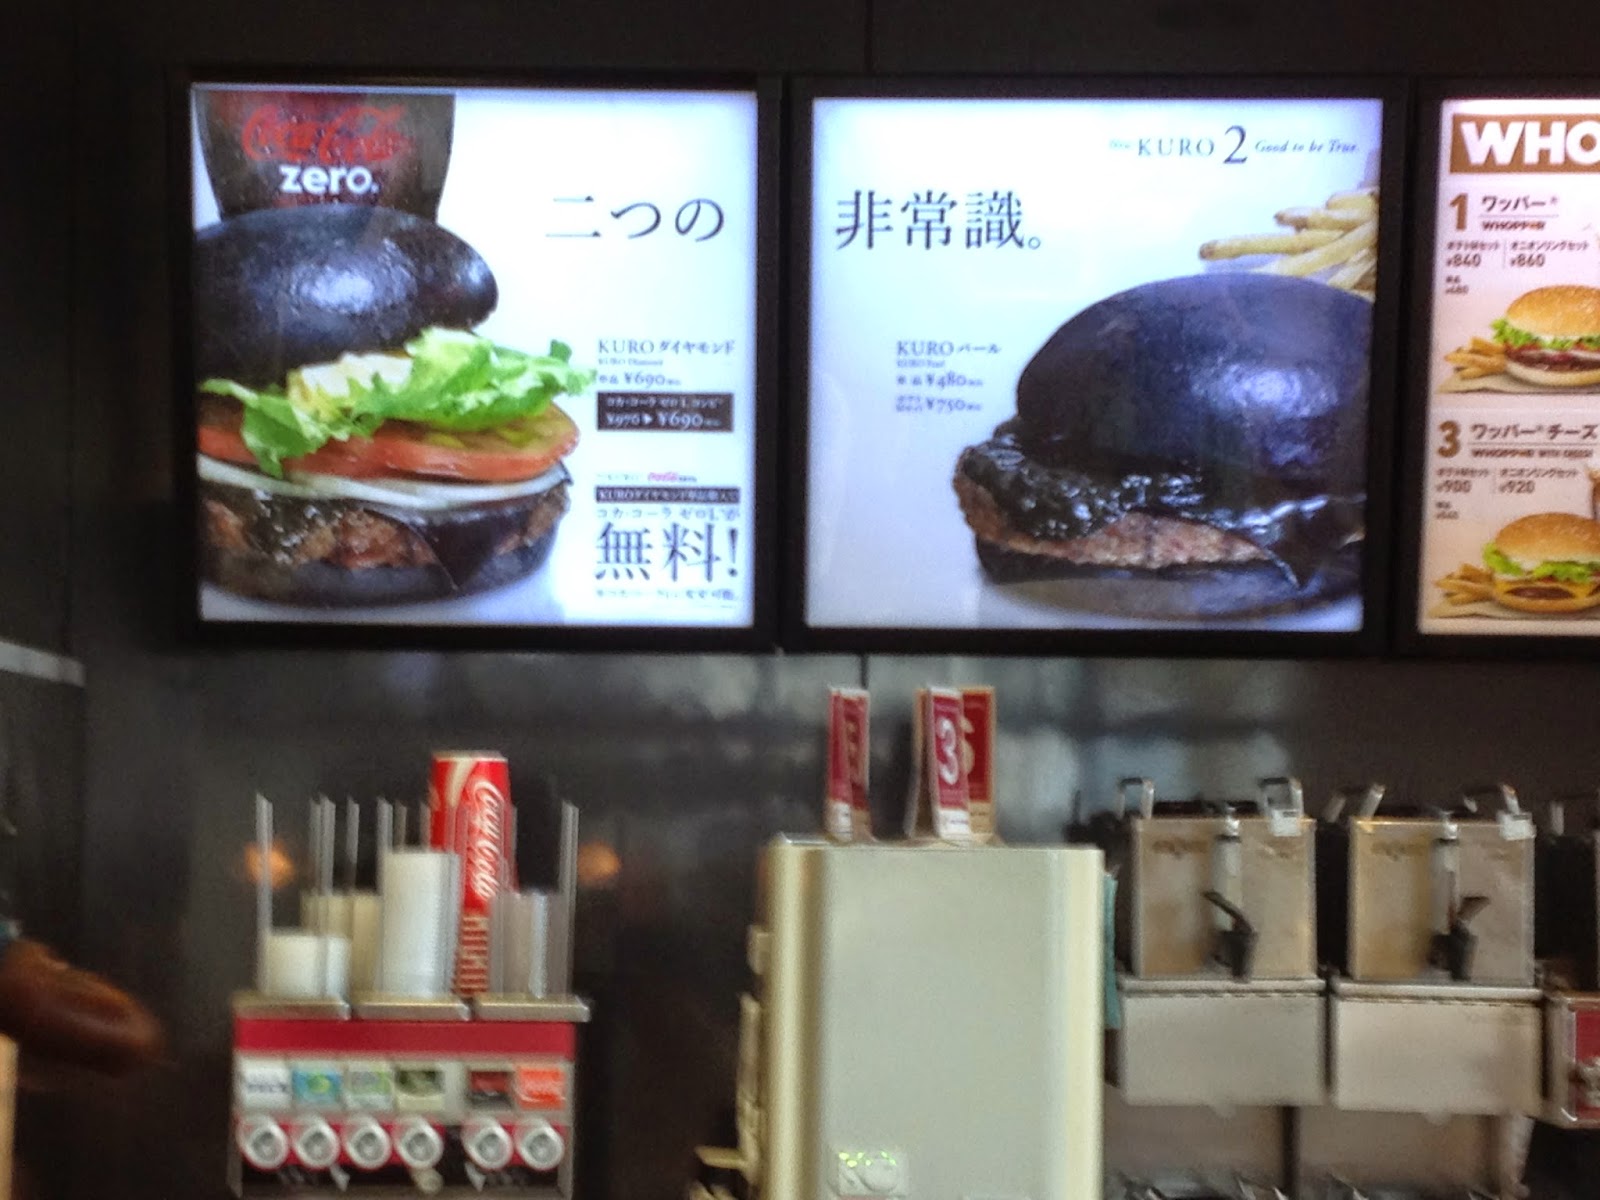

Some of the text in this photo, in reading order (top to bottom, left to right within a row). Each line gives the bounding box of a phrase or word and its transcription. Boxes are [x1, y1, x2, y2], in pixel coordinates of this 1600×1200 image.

[1137, 138, 1215, 157] KURO
[1222, 124, 1248, 165] 2
[1254, 139, 1288, 153] Good
[1460, 120, 1600, 166] WHO
[545, 194, 725, 243] 二つの
[835, 189, 1042, 251] 非常識。
[1449, 192, 1469, 232] 1
[597, 339, 655, 354] KURO
[897, 340, 955, 356] KURO
[1438, 420, 1461, 458] 3
[935, 717, 958, 785] 3
